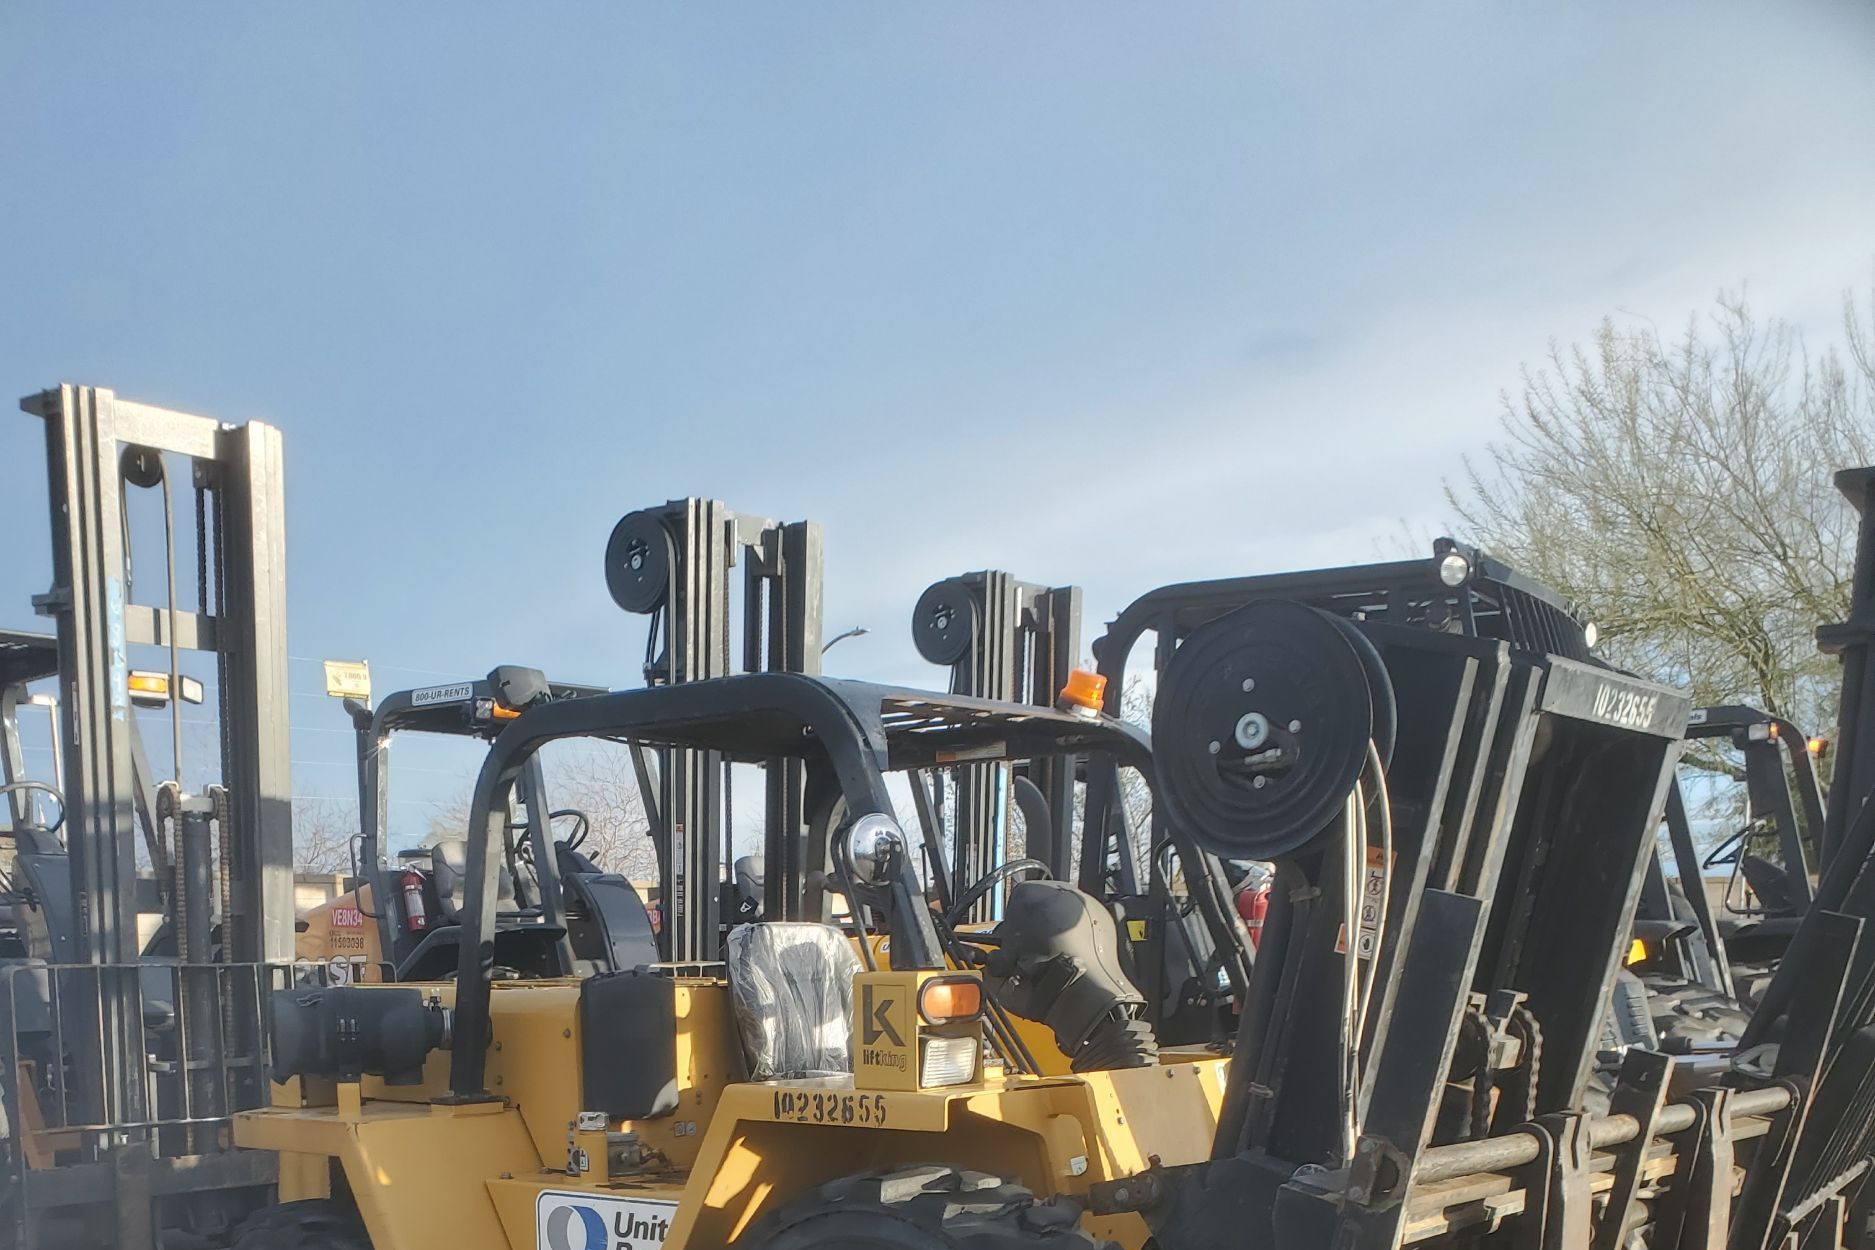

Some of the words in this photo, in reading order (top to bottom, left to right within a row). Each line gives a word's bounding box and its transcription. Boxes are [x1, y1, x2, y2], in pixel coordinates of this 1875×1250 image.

[415, 687, 470, 702] 800-UR-RENTS
[1593, 683, 1657, 728] 10232655
[863, 1049, 907, 1072] liftking
[774, 1091, 886, 1126] 10232655
